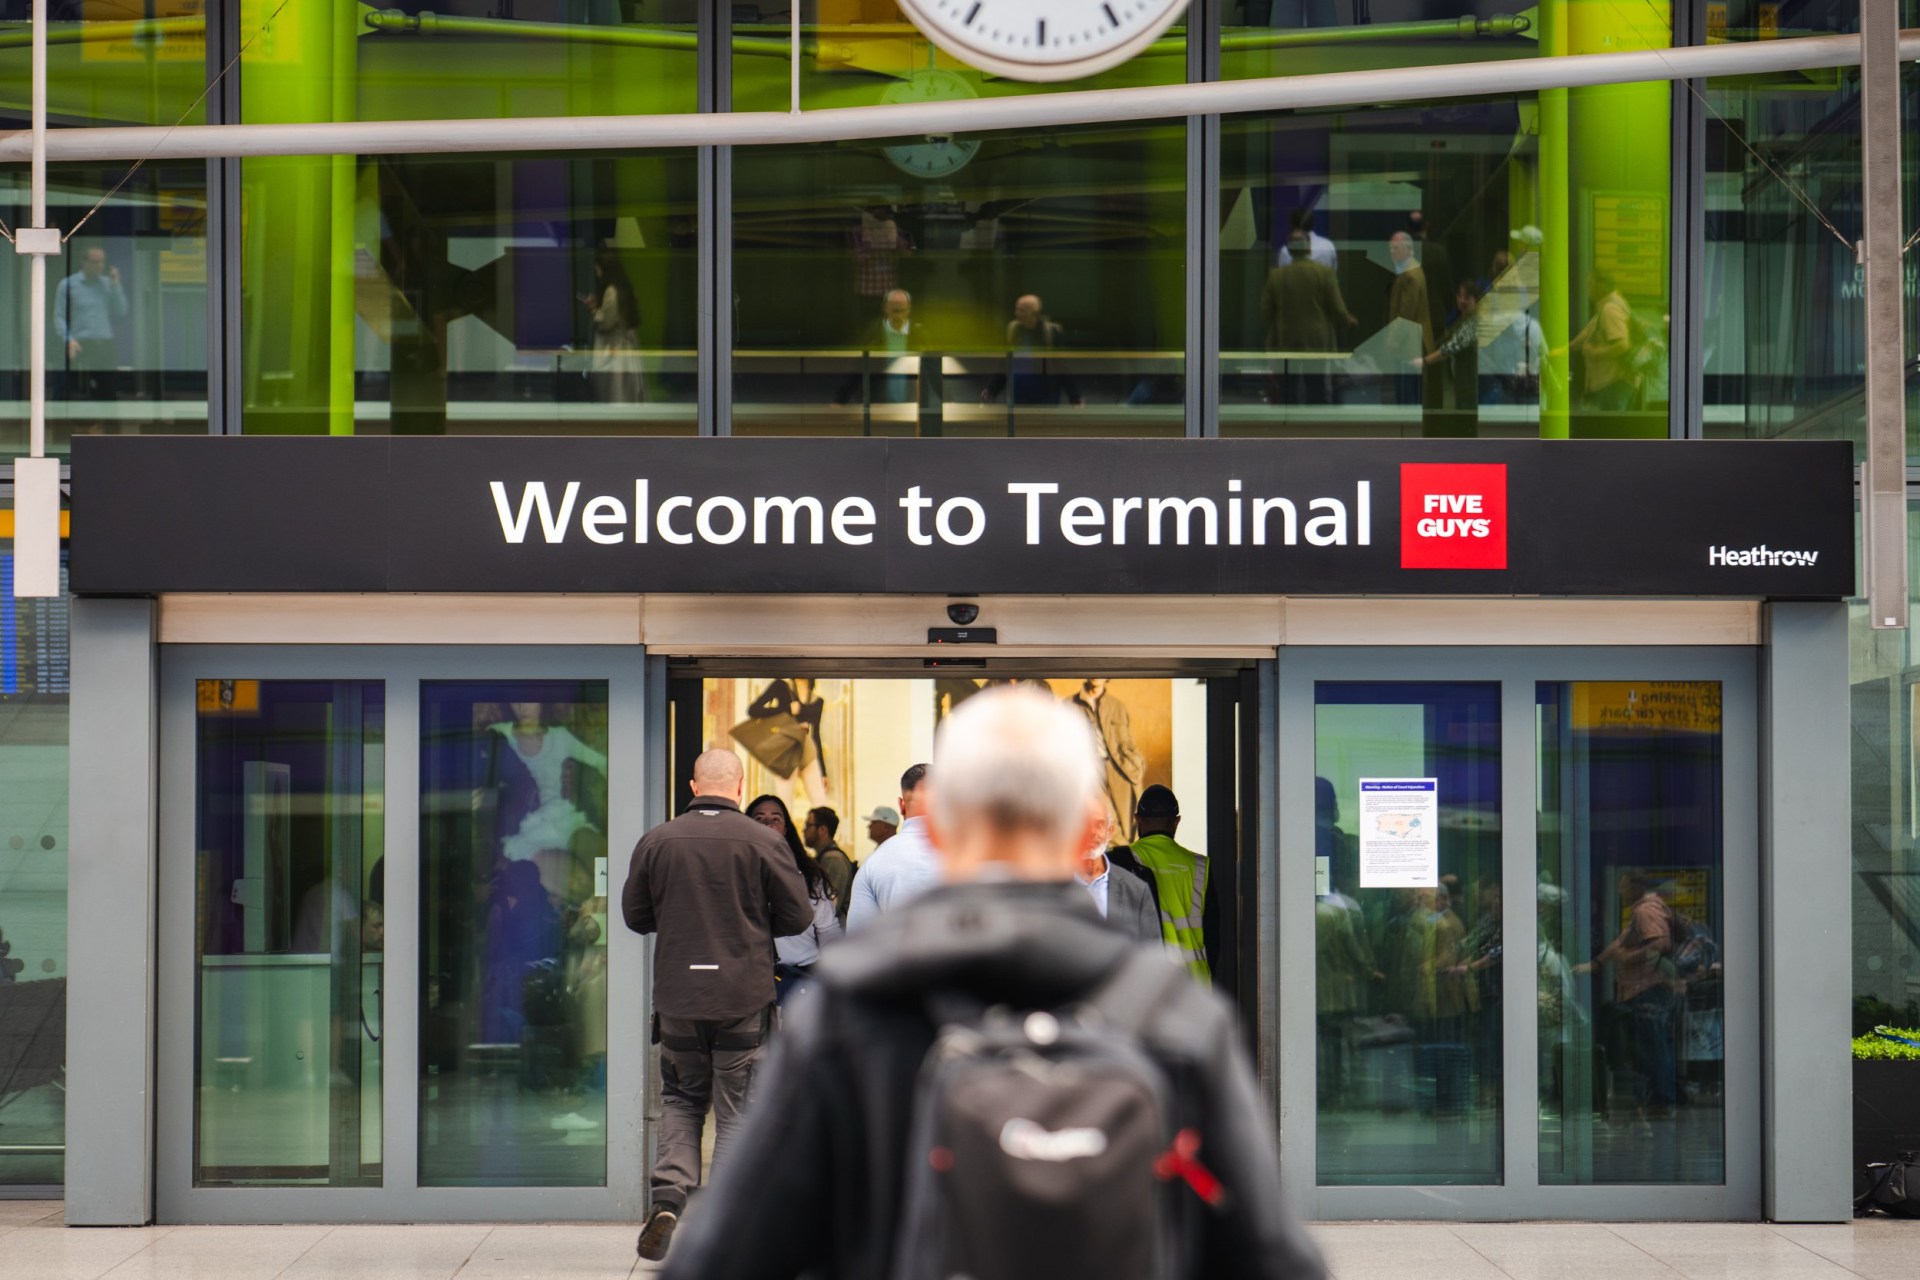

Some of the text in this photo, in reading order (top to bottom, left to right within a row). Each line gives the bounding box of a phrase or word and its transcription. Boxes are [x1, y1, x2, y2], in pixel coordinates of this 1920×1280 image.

[490, 479, 1370, 546] Welcome to Terminal
[1424, 494, 1483, 513] FIVE
[1416, 518, 1490, 538] GUYS
[1709, 544, 1819, 566] Heathrow
